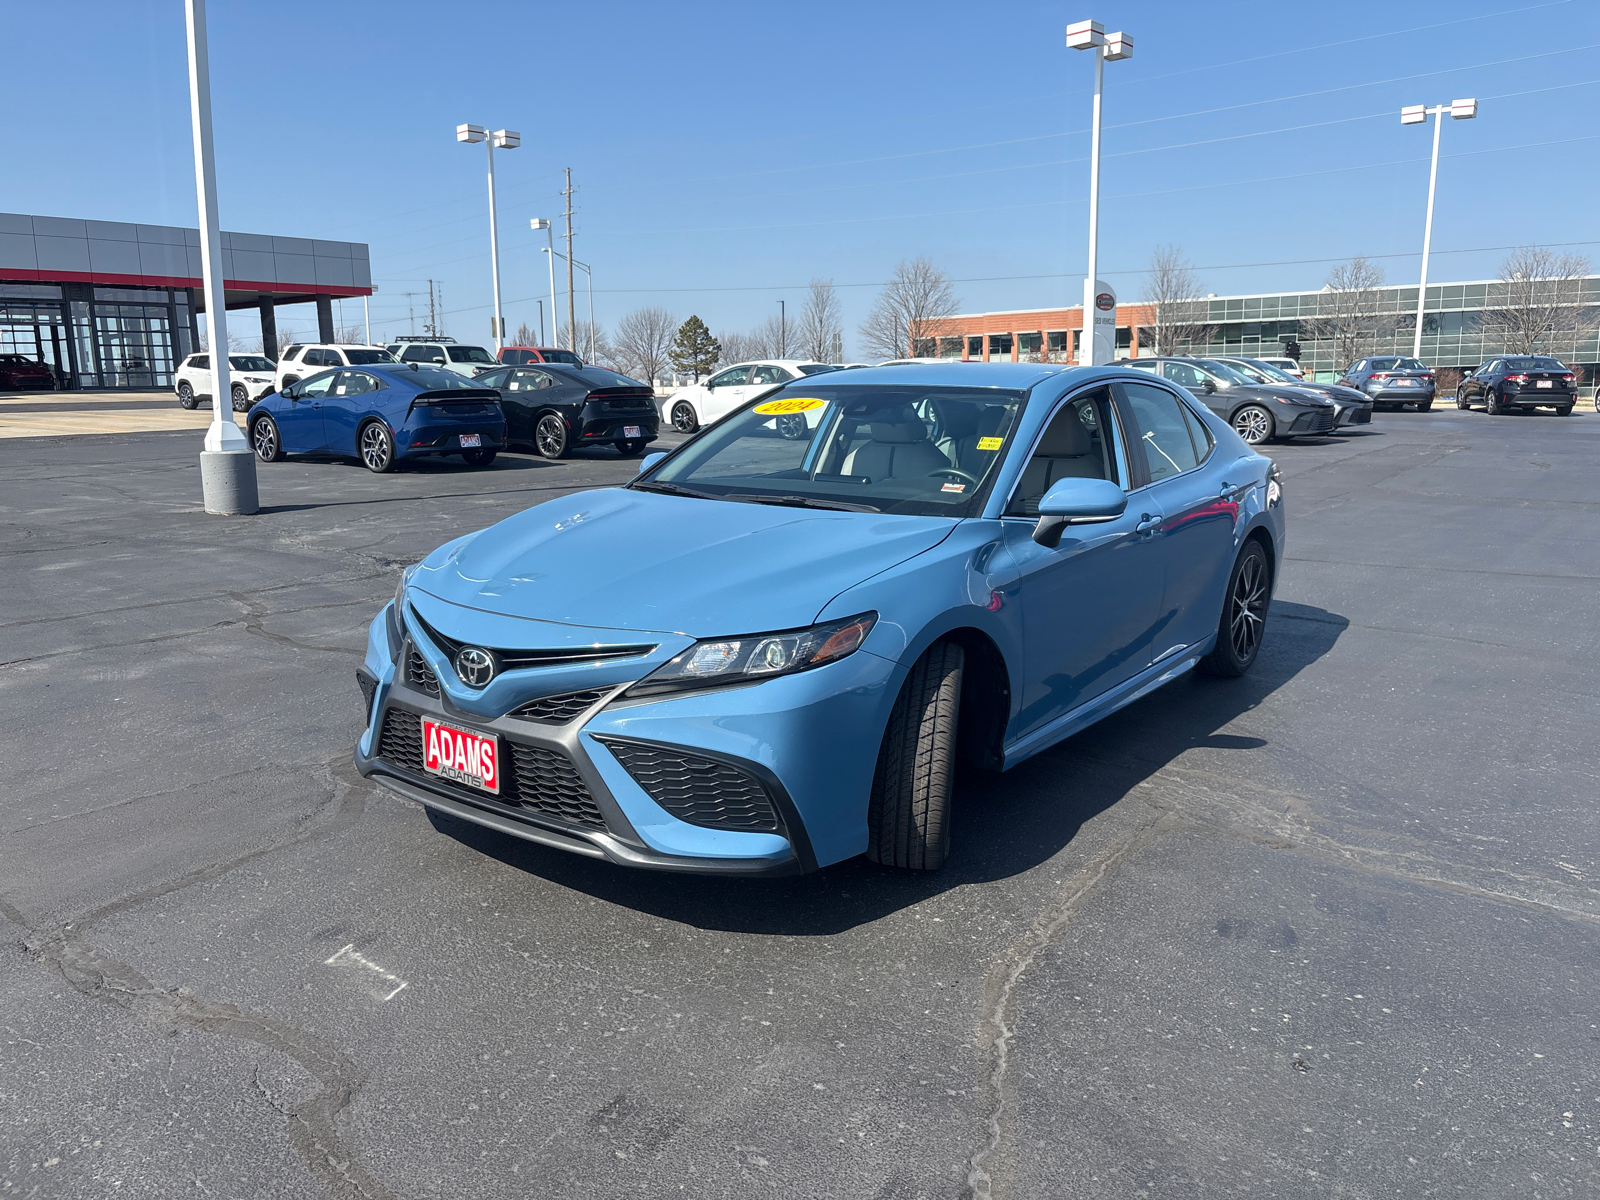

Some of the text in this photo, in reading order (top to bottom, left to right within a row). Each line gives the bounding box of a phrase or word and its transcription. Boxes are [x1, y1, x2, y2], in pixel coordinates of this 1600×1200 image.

[761, 400, 818, 412] 2024
[460, 436, 479, 444] ADAMS
[440, 720, 477, 735] KANSAS CITY
[428, 727, 494, 781] ADAMS
[440, 765, 482, 788] ADAMS
